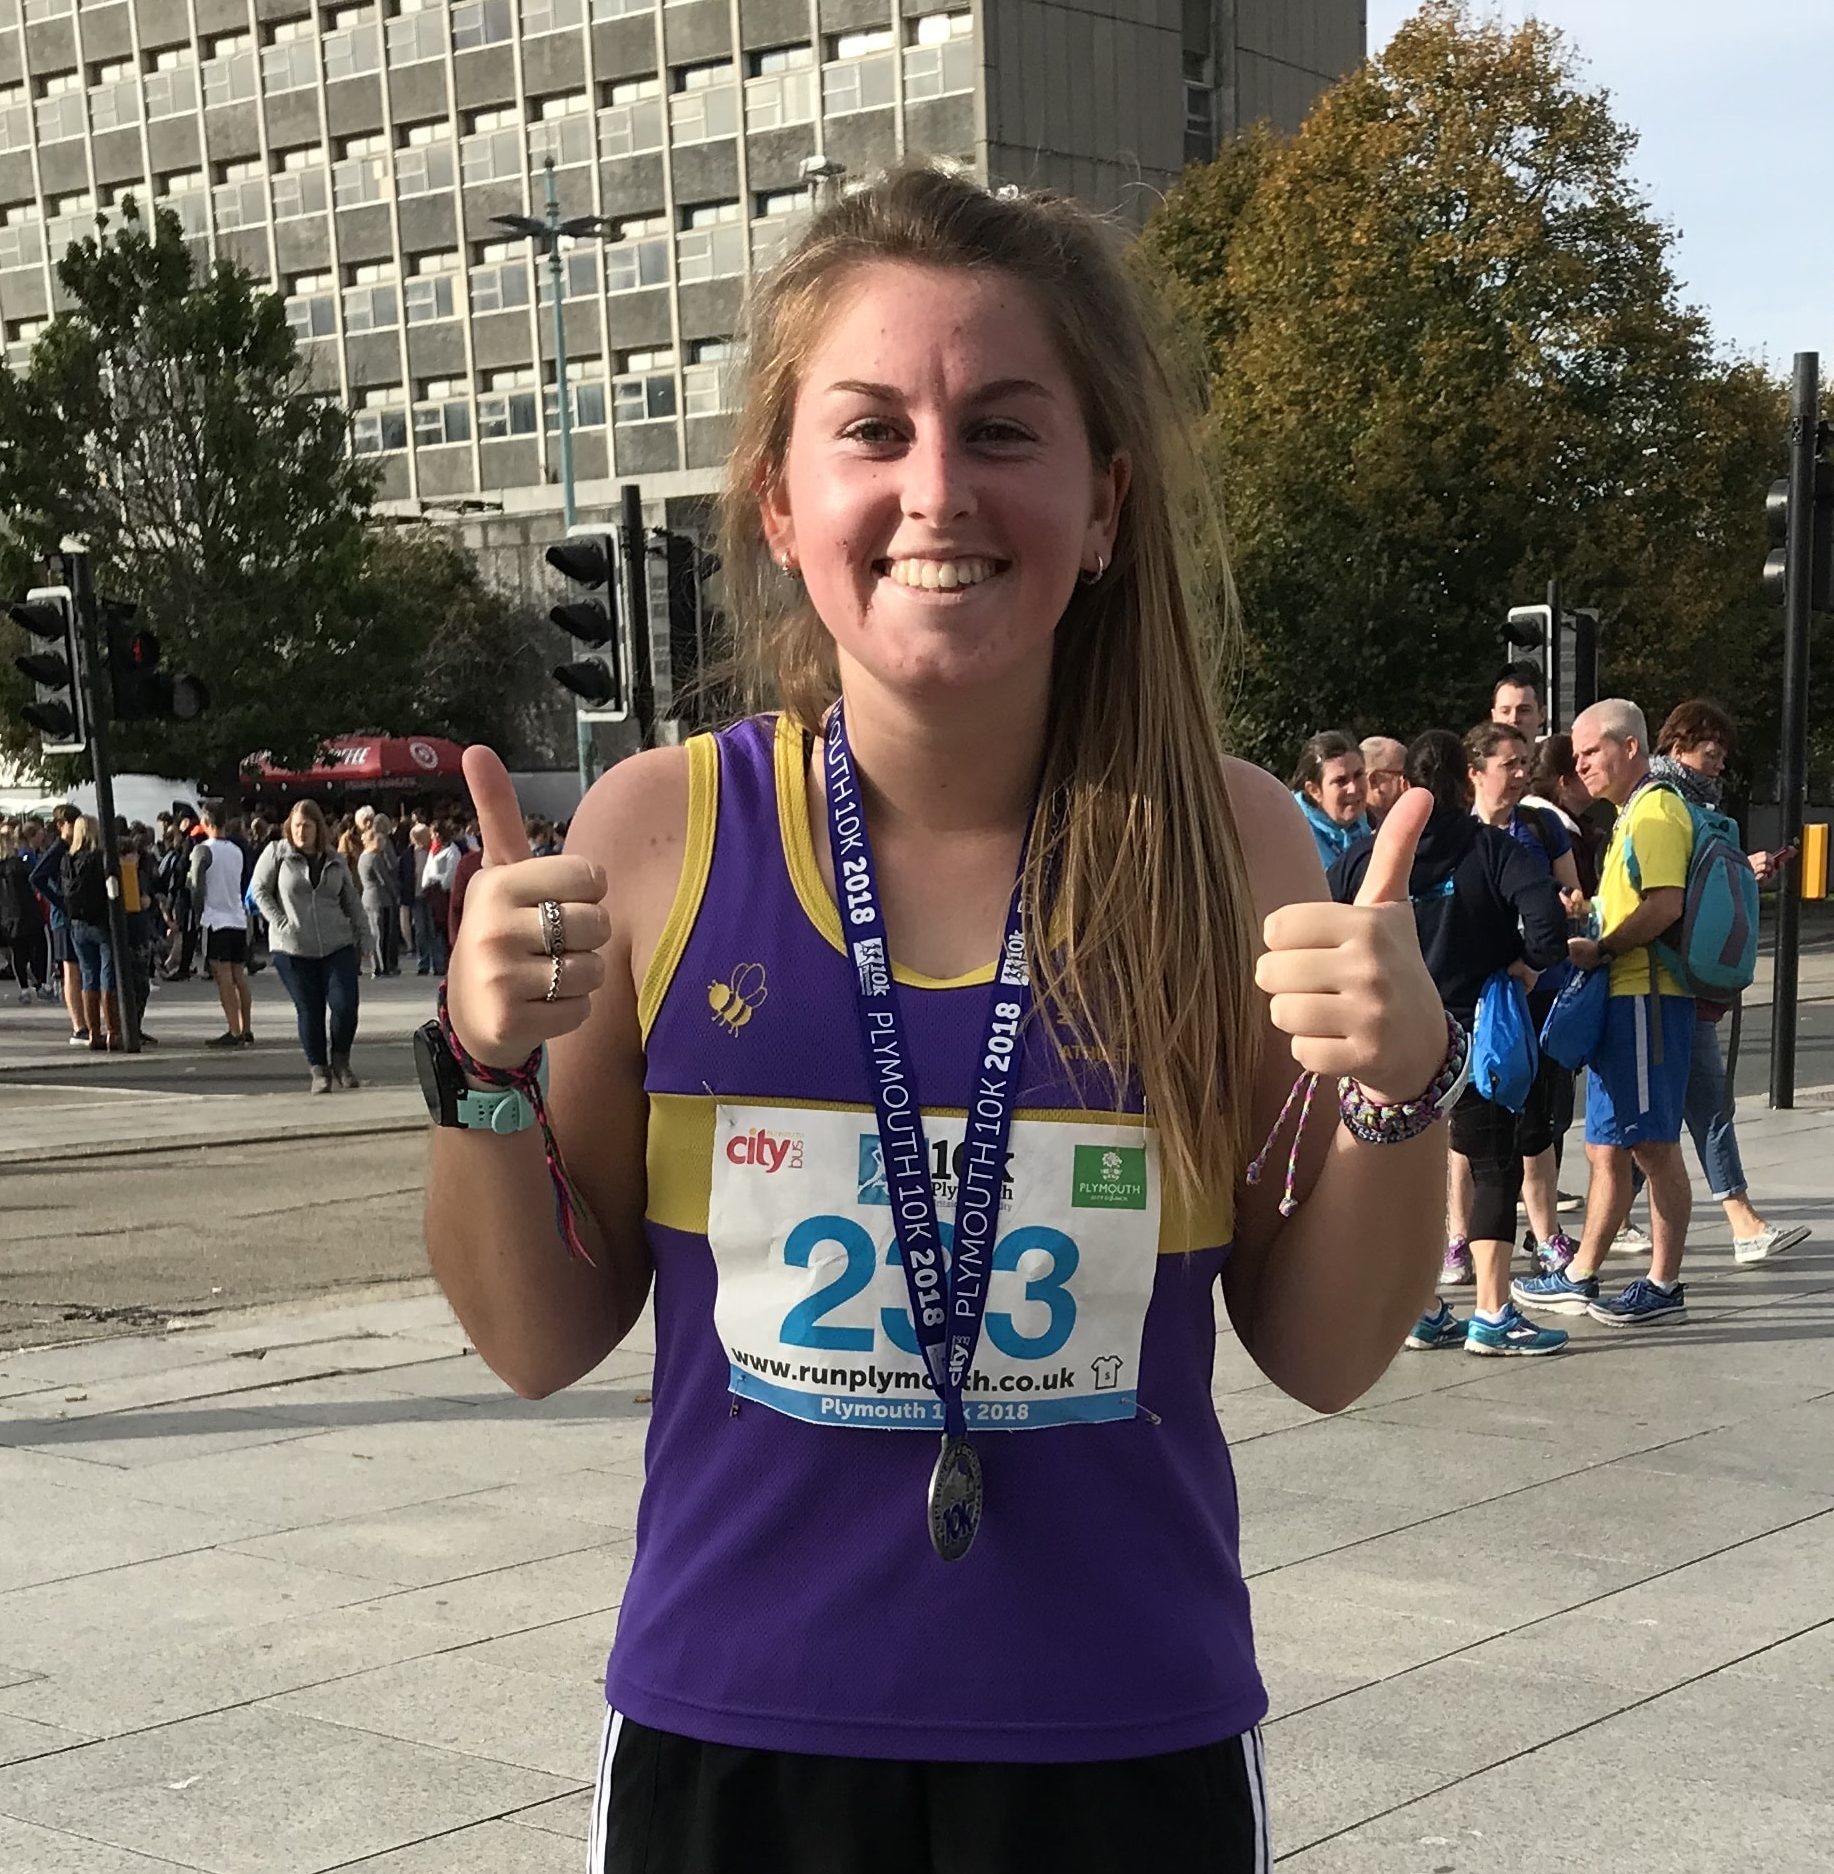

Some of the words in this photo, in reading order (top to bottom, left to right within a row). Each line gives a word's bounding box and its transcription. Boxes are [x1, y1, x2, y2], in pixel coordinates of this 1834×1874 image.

[835, 801, 864, 855] 10K
[843, 856, 876, 925] 2018
[984, 1002, 1021, 1072] 2018
[867, 1012, 922, 1177] PLYMOUTH
[974, 1077, 1007, 1136] 10K
[726, 1127, 791, 1173] city
[897, 1185, 932, 1242] 10K
[1079, 1182, 1141, 1194] PLYMOUTH
[955, 1141, 998, 1317] PLYMOUTH
[910, 1248, 946, 1327] 2018
[821, 1397, 926, 1420] Plymouth
[977, 1402, 1029, 1420] 2018
